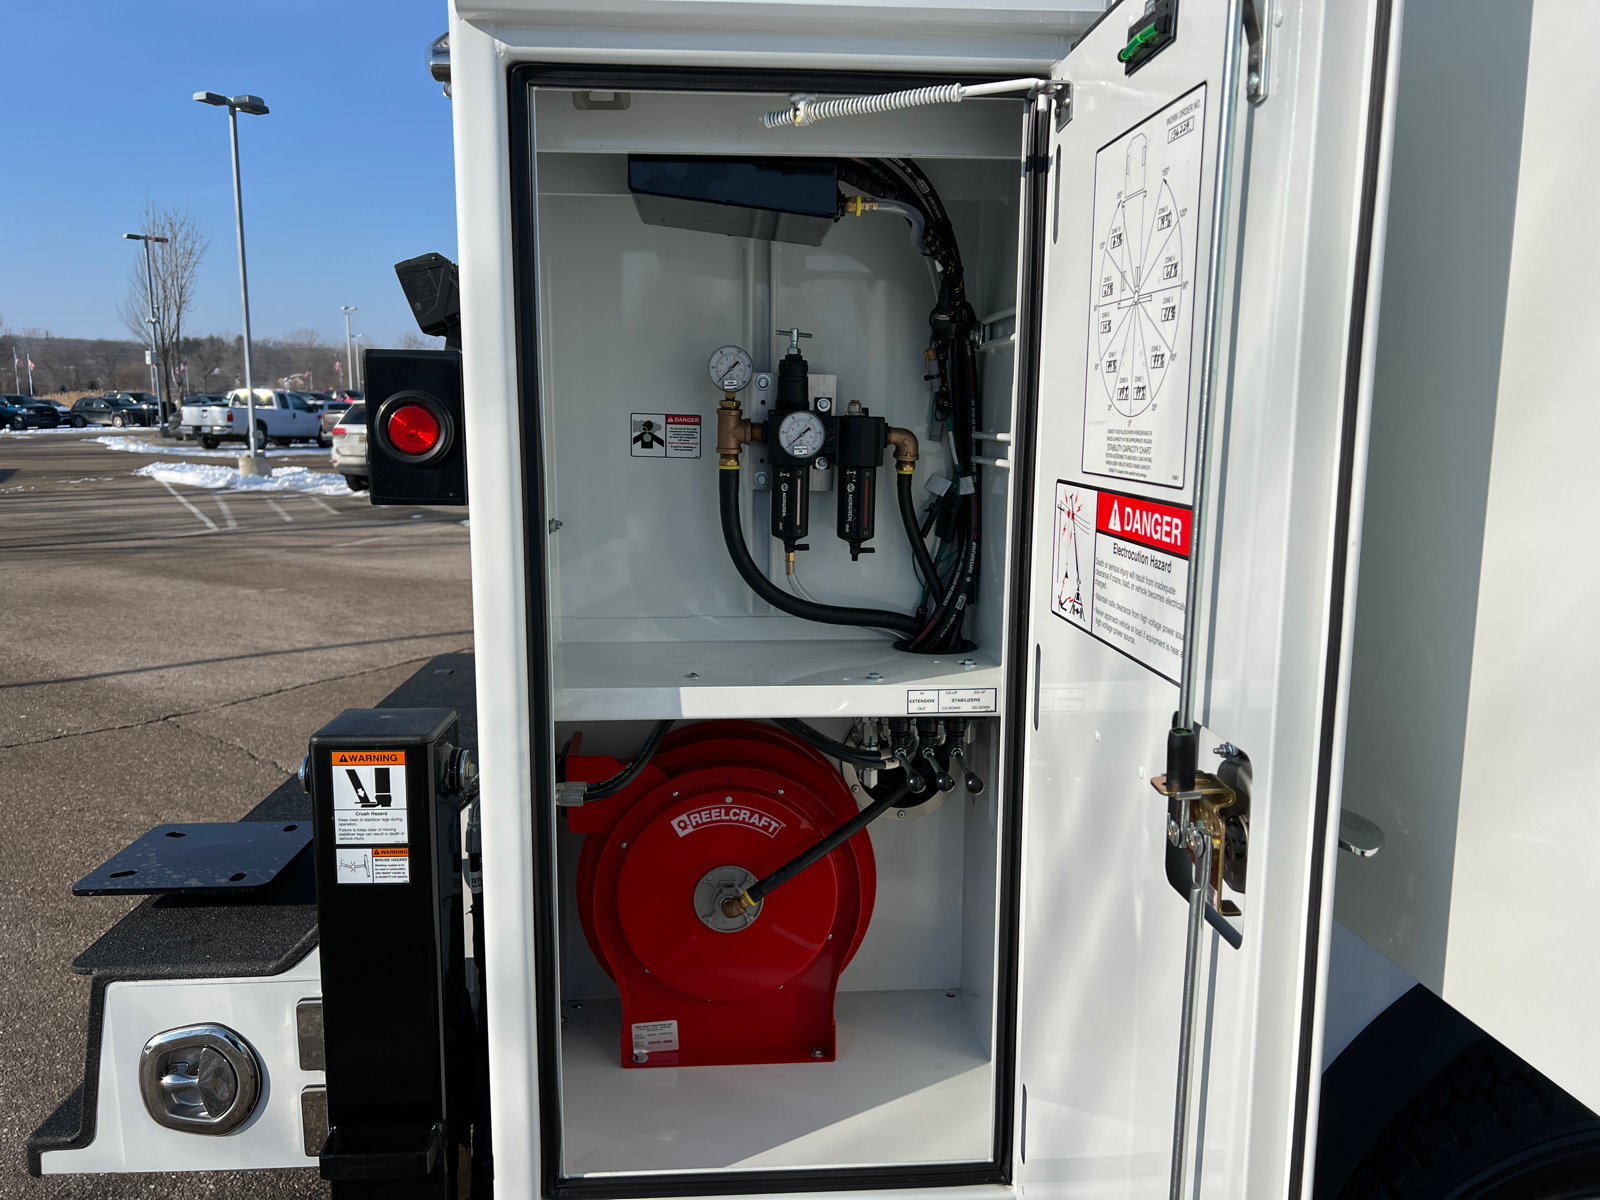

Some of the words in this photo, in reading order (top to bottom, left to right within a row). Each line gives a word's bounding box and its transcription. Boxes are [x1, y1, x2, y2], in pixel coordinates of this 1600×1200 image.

[1166, 113, 1178, 127] WORK
[1179, 104, 1193, 119] ORDER
[1107, 443, 1122, 452] STABILITY
[1122, 444, 1138, 454] CAPACITY
[1139, 446, 1151, 455] CHART
[1123, 506, 1182, 546] DANGER
[968, 542, 977, 574] INTERPUMP
[1113, 542, 1148, 565] Electrocution
[1149, 554, 1171, 573] Hazard
[1108, 562, 1119, 573] serious
[1119, 566, 1128, 578] injury
[1135, 572, 1144, 583] result
[1154, 579, 1175, 597] inadequate
[1135, 584, 1147, 595] vehicle
[1148, 589, 1164, 603] becomes
[1102, 620, 1112, 634] voltage
[1113, 627, 1122, 639] power
[1104, 611, 1118, 626] approach
[1119, 618, 1130, 631] vehicle
[1146, 632, 1165, 651] equipment
[1170, 646, 1179, 657] near
[1115, 602, 1130, 616] clearance
[1148, 617, 1161, 632] voltage
[1162, 625, 1174, 639] power
[689, 808, 779, 833] REELCRAFT
